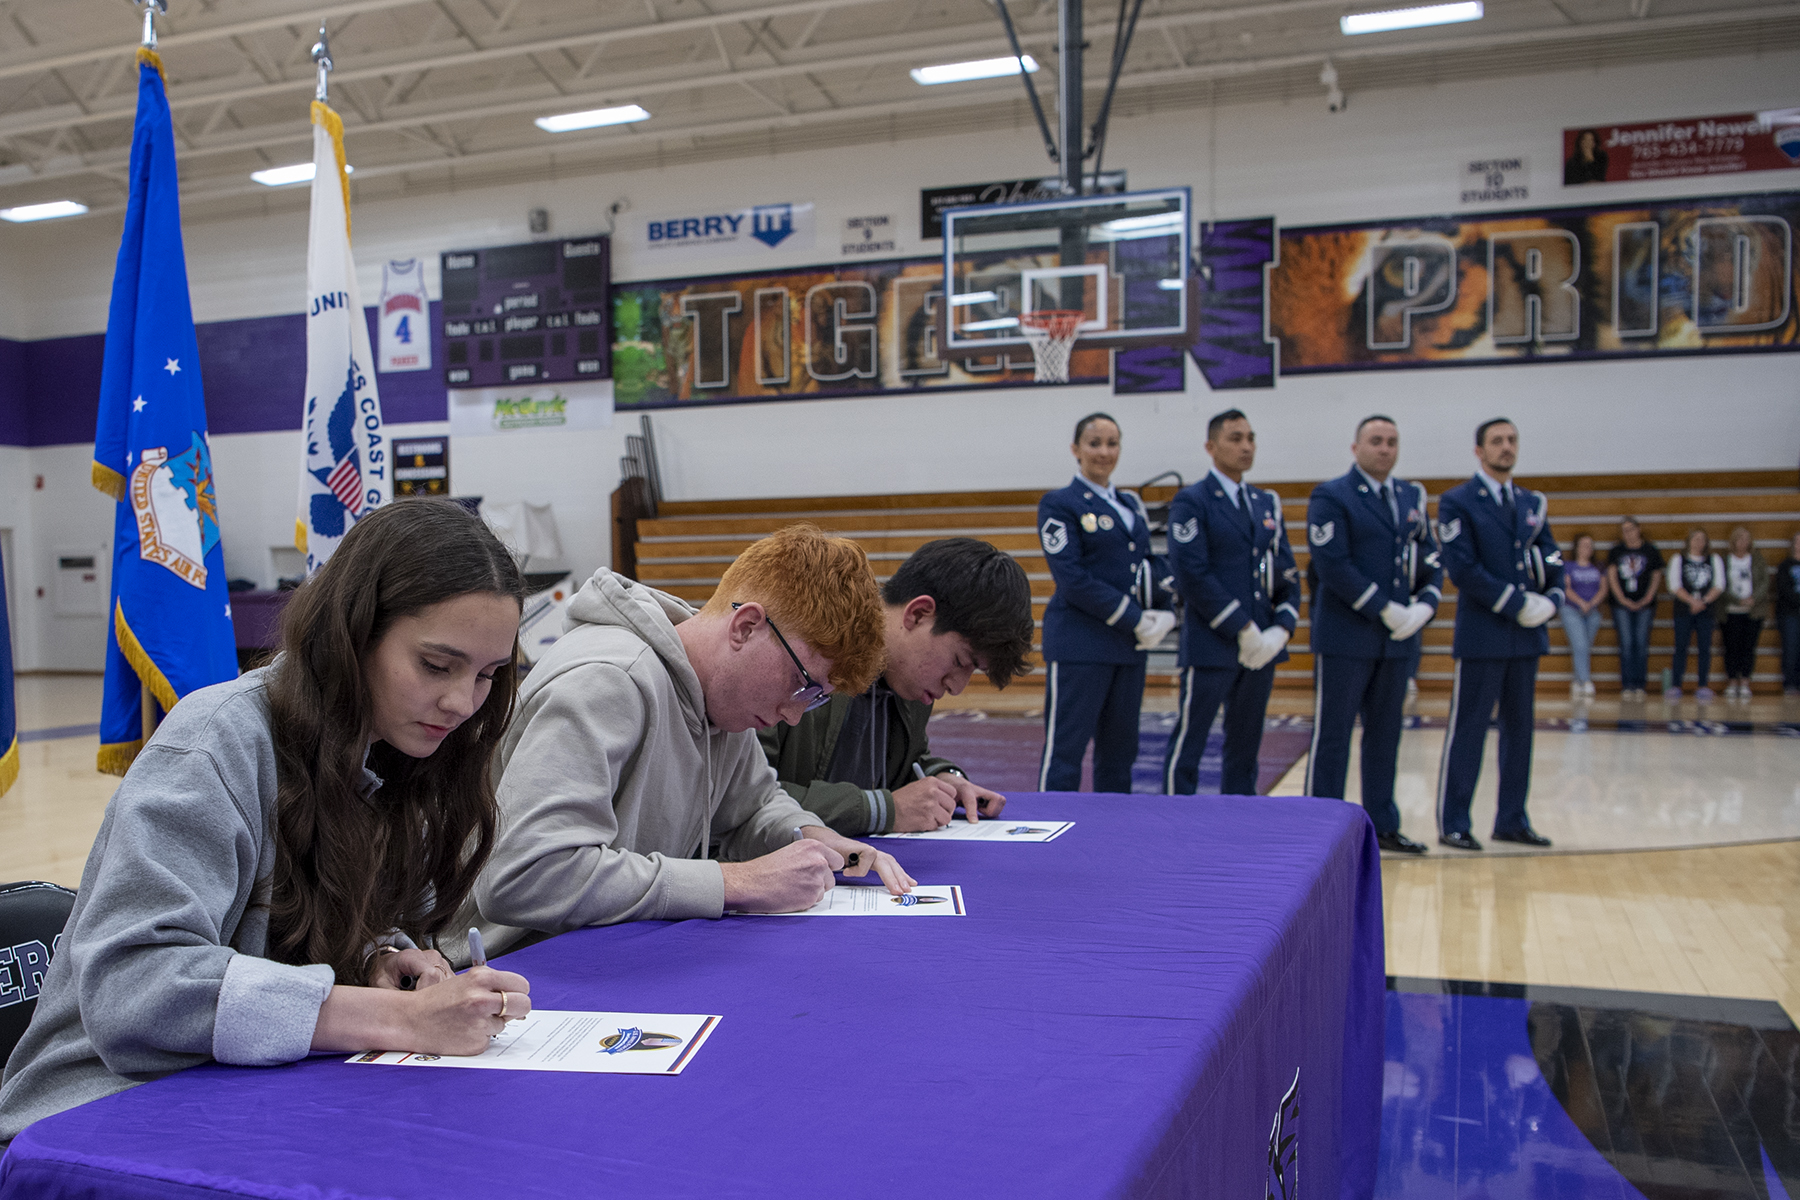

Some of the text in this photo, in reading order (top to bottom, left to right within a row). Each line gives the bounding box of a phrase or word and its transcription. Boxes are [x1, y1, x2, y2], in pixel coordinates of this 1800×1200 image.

[1606, 122, 1695, 149] Jennifer
[1461, 187, 1528, 203] STUDENTS
[648, 214, 743, 242] BERRY
[842, 242, 895, 254] STUDENTS
[396, 315, 411, 343] 4
[360, 398, 384, 480] COAST
[133, 463, 158, 510] UNITED
[139, 512, 172, 563] STATES
[169, 556, 193, 579] AIR
[0, 932, 63, 1009] ER
